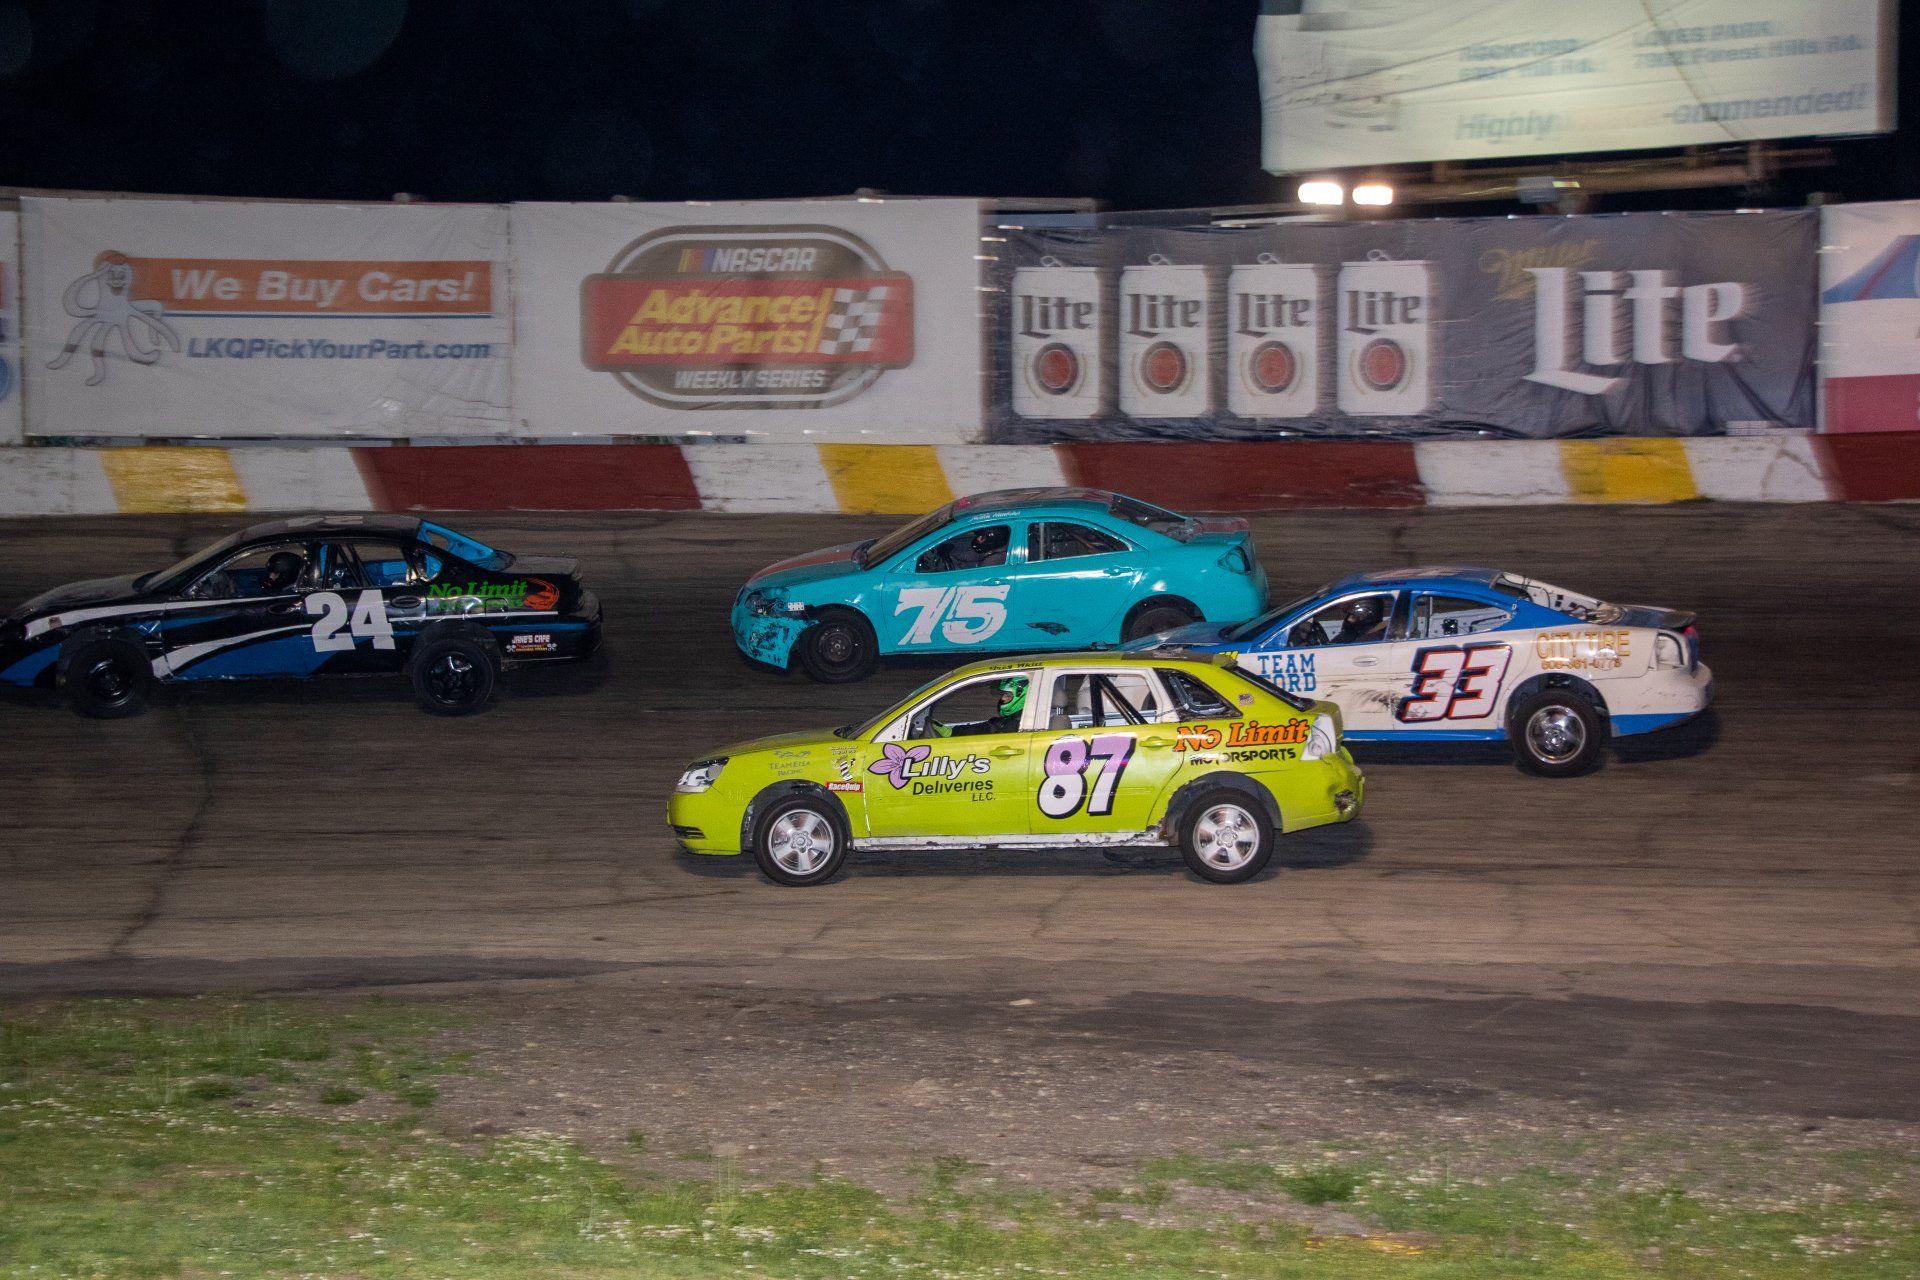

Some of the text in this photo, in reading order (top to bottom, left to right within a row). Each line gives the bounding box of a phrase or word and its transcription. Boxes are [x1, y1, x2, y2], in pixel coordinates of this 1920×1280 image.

[711, 247, 818, 273] NASCAR
[170, 267, 477, 308] We Buy Cars!
[1018, 294, 1094, 339] Lite
[1126, 292, 1201, 339] Lite
[1235, 292, 1312, 338] Lite
[1344, 289, 1422, 336] Lite
[606, 324, 702, 355] Auto
[1522, 266, 1748, 396] Lite
[186, 338, 491, 361] LKQPickYourPart.com
[674, 368, 827, 390] WEEKLY SERIES
[427, 579, 528, 598] No Limit
[304, 588, 396, 653] 24
[893, 584, 1010, 647] 75
[534, 634, 550, 643] CAFE
[1537, 629, 1631, 659] CITY TIRE
[1257, 653, 1316, 675] TEAM
[1396, 642, 1512, 723] 33
[1172, 716, 1310, 753] No Limit
[902, 754, 991, 780] Lilly's
[1190, 747, 1297, 767] MOTORSPORTS
[828, 782, 861, 791] RaceQuip
[912, 779, 994, 796] Deliveries
[1037, 734, 1138, 820] 87
[971, 791, 996, 804] LLC.
